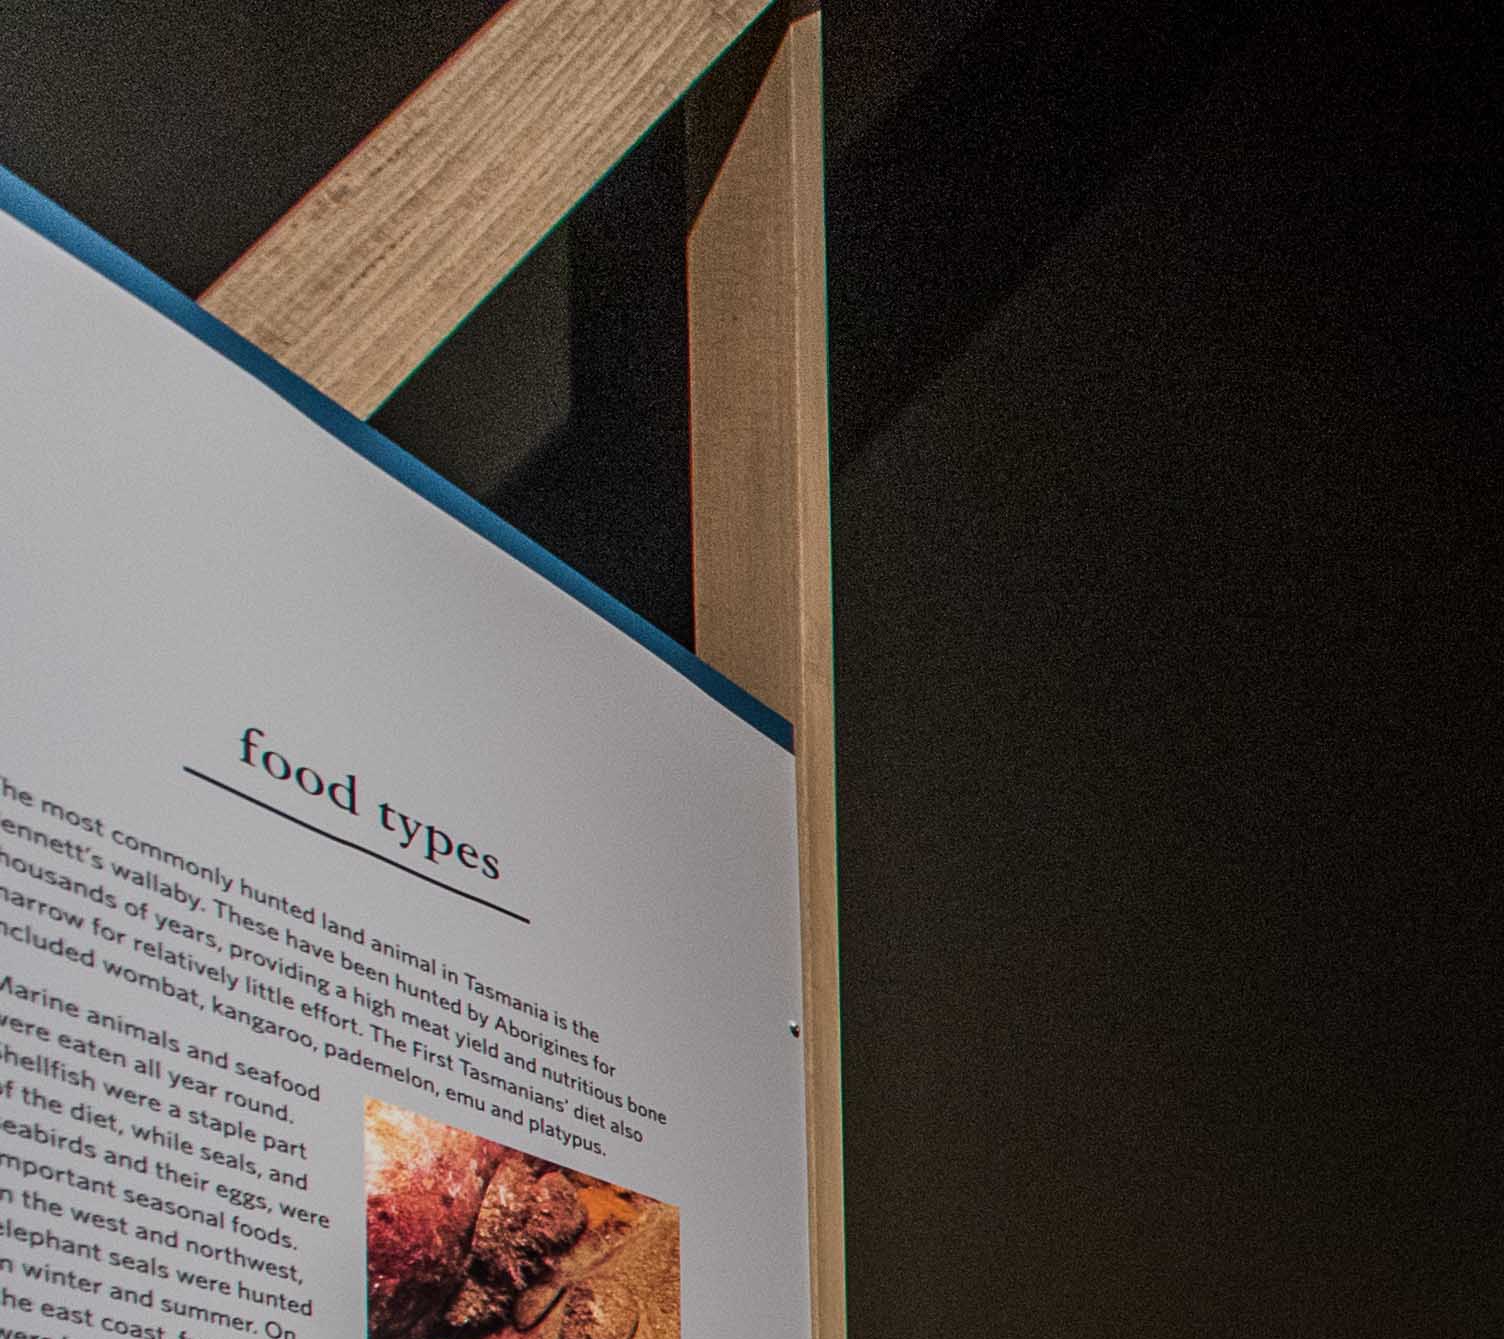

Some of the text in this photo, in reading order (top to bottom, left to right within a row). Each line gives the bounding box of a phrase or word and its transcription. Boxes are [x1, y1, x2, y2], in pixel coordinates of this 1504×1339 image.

[1, 777, 600, 1044] he most commonly hunted land animal in Tasmania is the
[240, 726, 502, 882] food types
[0, 818, 617, 1078] ennett's wallaby. These have been hunted by Aborigines for
[0, 850, 667, 1126] housands of years, providing a high meat yield and nutritious bone
[0, 920, 606, 1157] ncluded wombat, kangaroo, pademelon, emu and platypus.
[86, 1009, 180, 1053] animals
[186, 1044, 229, 1070] and
[235, 1061, 320, 1102] seafood
[92, 917, 644, 1143] for relatively little effort. The First Tasmanians' diet also
[0, 1044, 308, 1161] hellfish were a staple part
